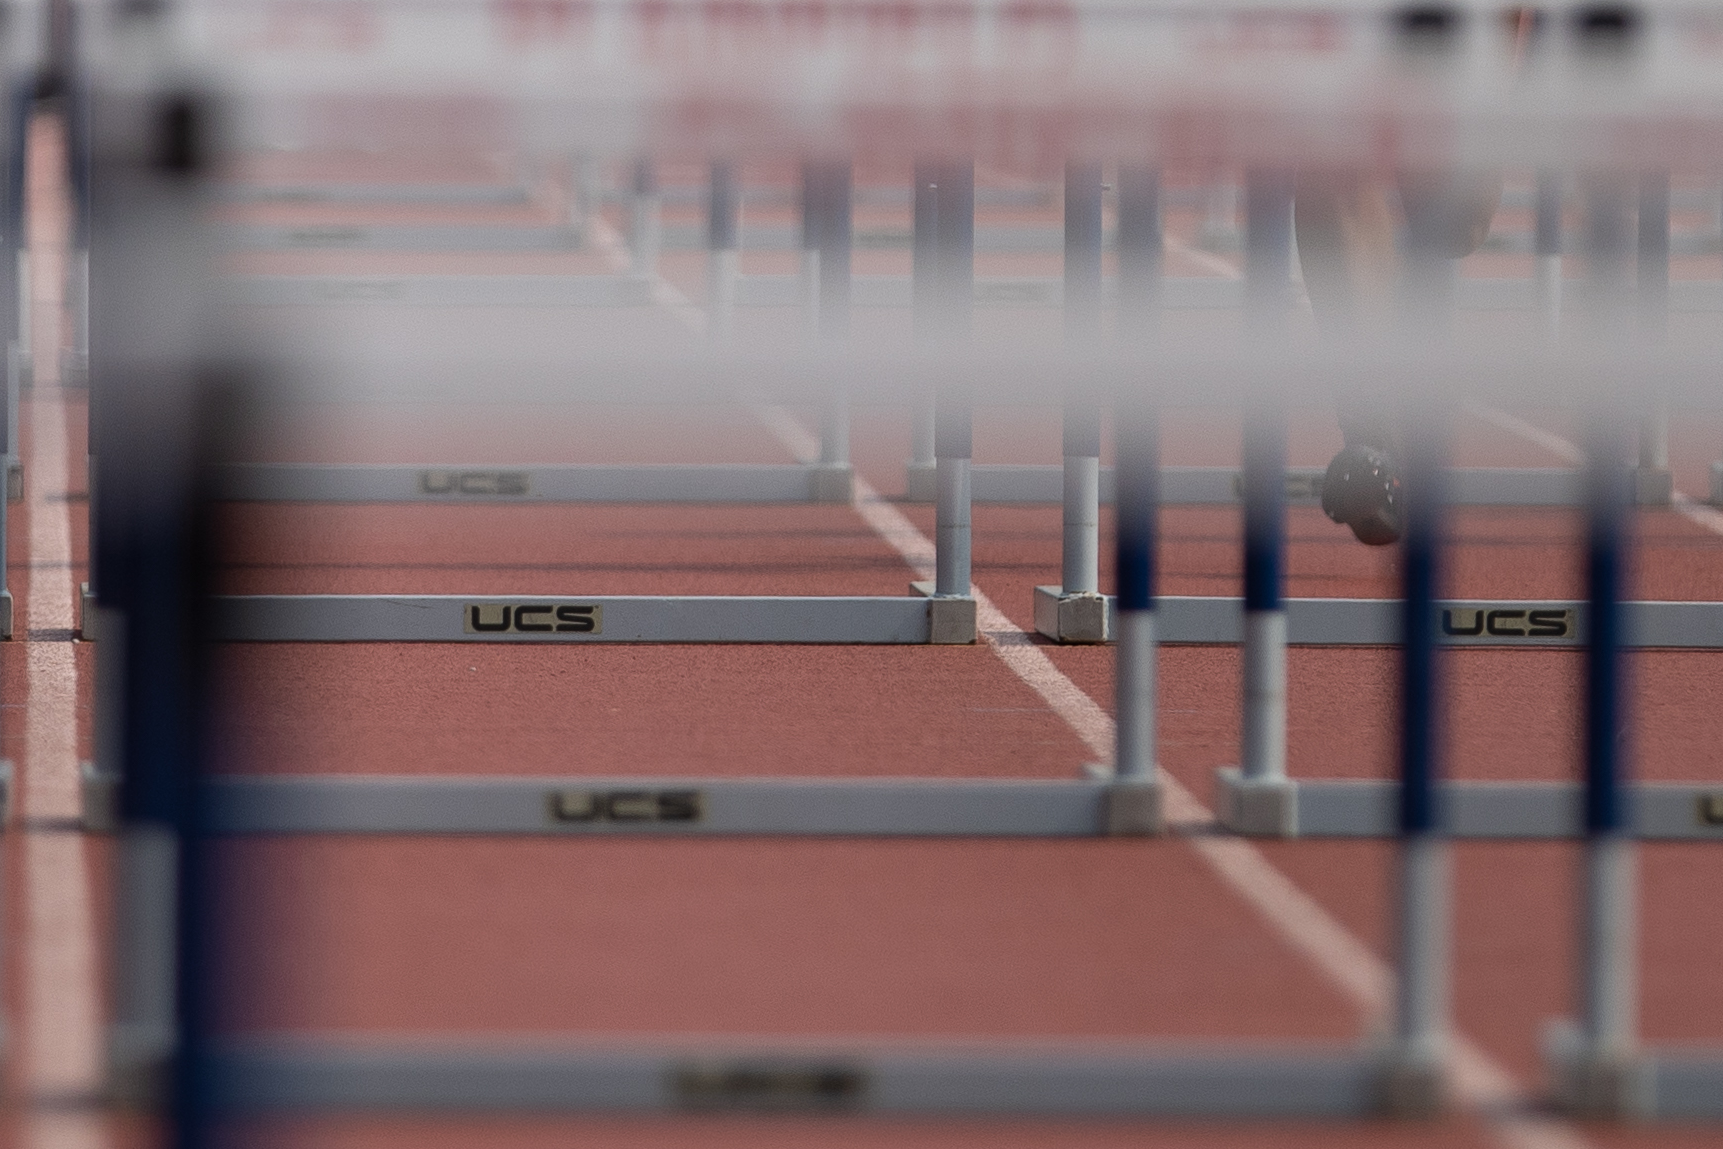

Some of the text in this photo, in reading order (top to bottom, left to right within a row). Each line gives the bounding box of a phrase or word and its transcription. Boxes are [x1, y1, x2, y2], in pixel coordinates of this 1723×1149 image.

[470, 605, 596, 632] UCS
[1442, 609, 1568, 637] UCS
[548, 790, 700, 823] UCS
